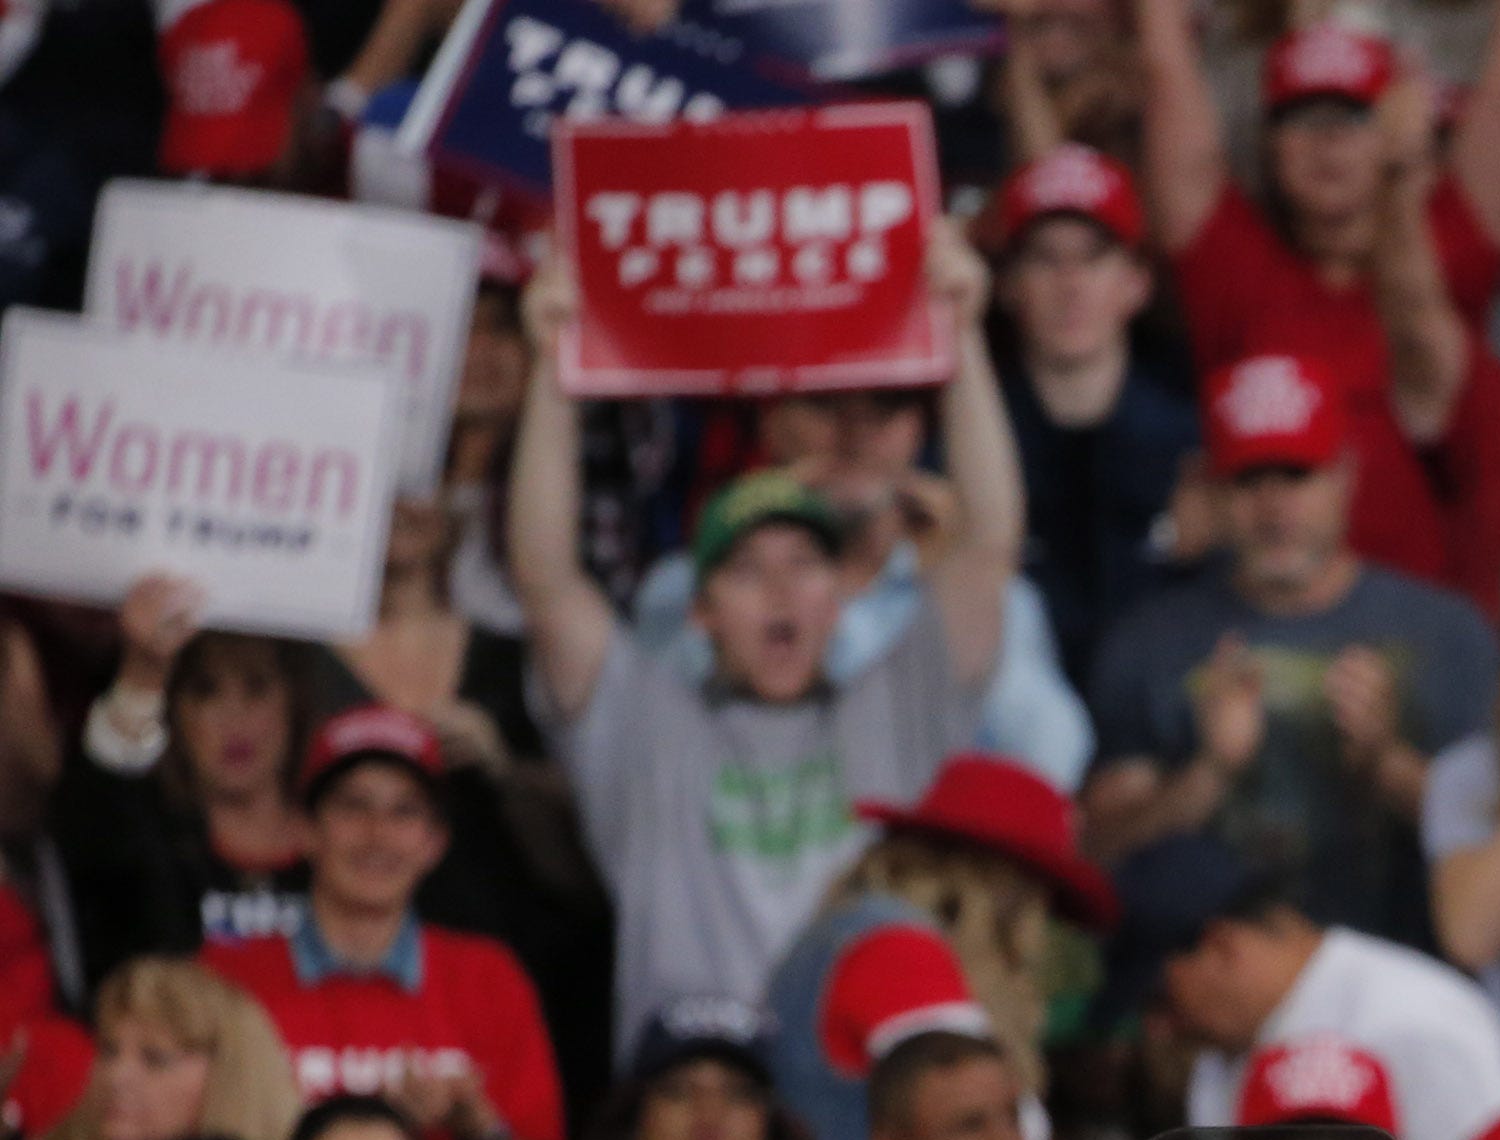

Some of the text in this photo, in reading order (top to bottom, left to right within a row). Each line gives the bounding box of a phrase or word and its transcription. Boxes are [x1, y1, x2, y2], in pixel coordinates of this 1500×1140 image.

[505, 14, 725, 126] TRU
[584, 180, 912, 251] TRUMP
[26, 390, 362, 524] Women
